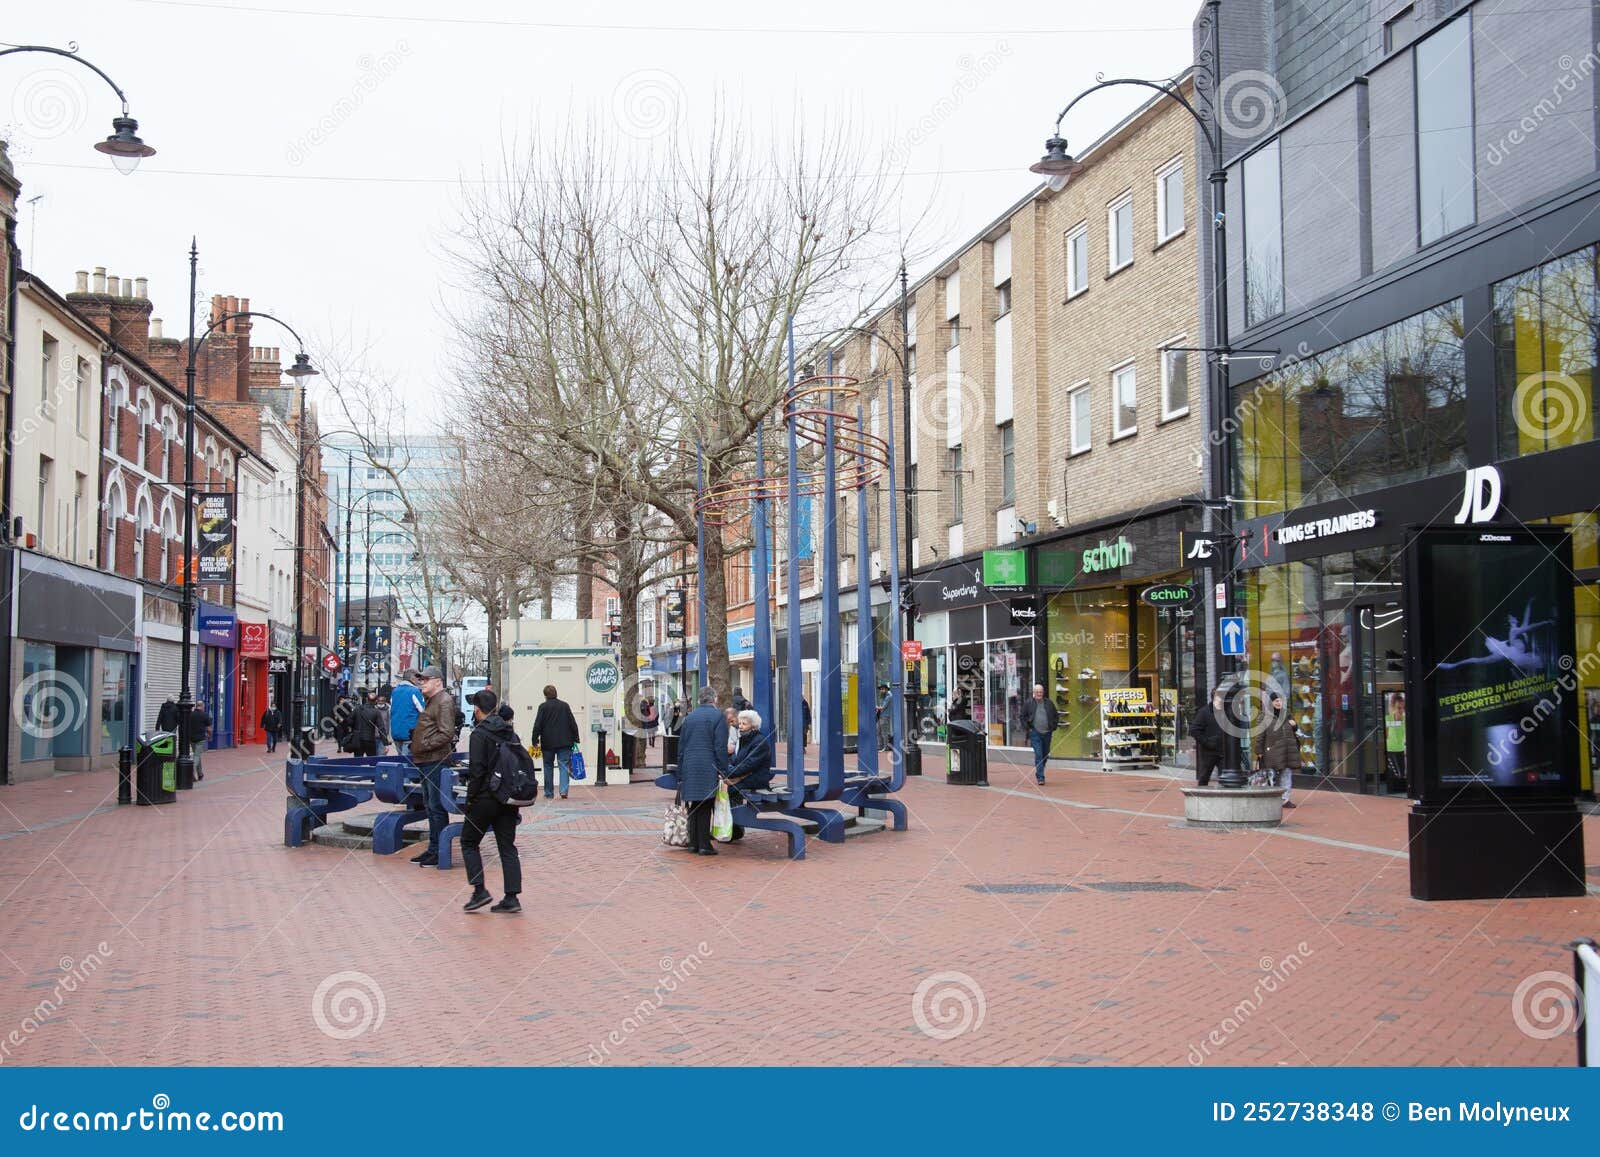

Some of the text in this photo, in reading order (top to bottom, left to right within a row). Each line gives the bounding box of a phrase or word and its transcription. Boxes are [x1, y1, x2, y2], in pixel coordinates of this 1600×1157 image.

[1454, 465, 1501, 524] JD
[1278, 509, 1376, 545] KING OF TRAINERS
[1479, 534, 1512, 542] JCDecaux
[1082, 536, 1132, 574] schuh
[1187, 539, 1213, 559] JD
[942, 583, 978, 601] Superdrug
[1150, 587, 1189, 600] schuh
[588, 675, 617, 685] WRAPS
[590, 667, 615, 677] SAM'S
[1102, 690, 1144, 701] OFFERS
[1440, 674, 1545, 706] PERFORMED IN LONDON
[1454, 694, 1501, 713] EXPORTED
[1503, 681, 1557, 701] WORLDWIDE
